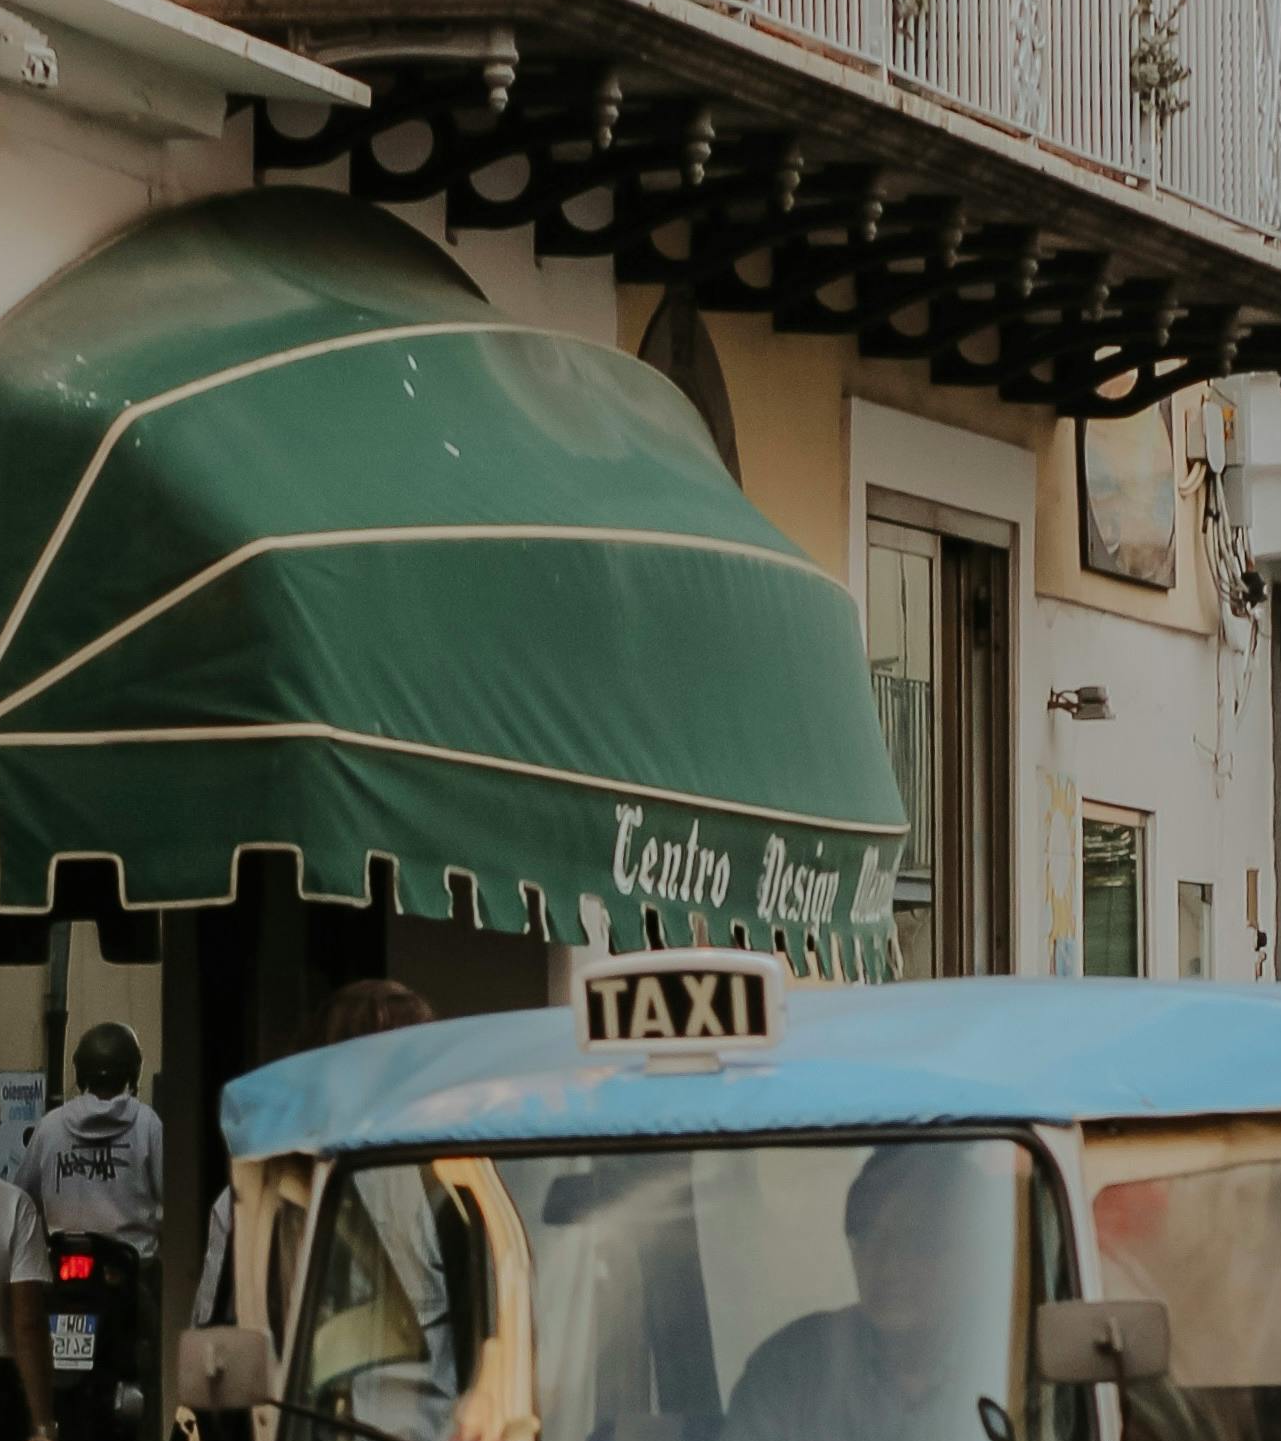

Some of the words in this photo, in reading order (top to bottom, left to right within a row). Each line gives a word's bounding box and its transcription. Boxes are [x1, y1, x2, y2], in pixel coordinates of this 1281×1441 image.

[612, 803, 731, 909] Centro
[756, 832, 840, 937] Design
[589, 974, 751, 1040] TAXI
